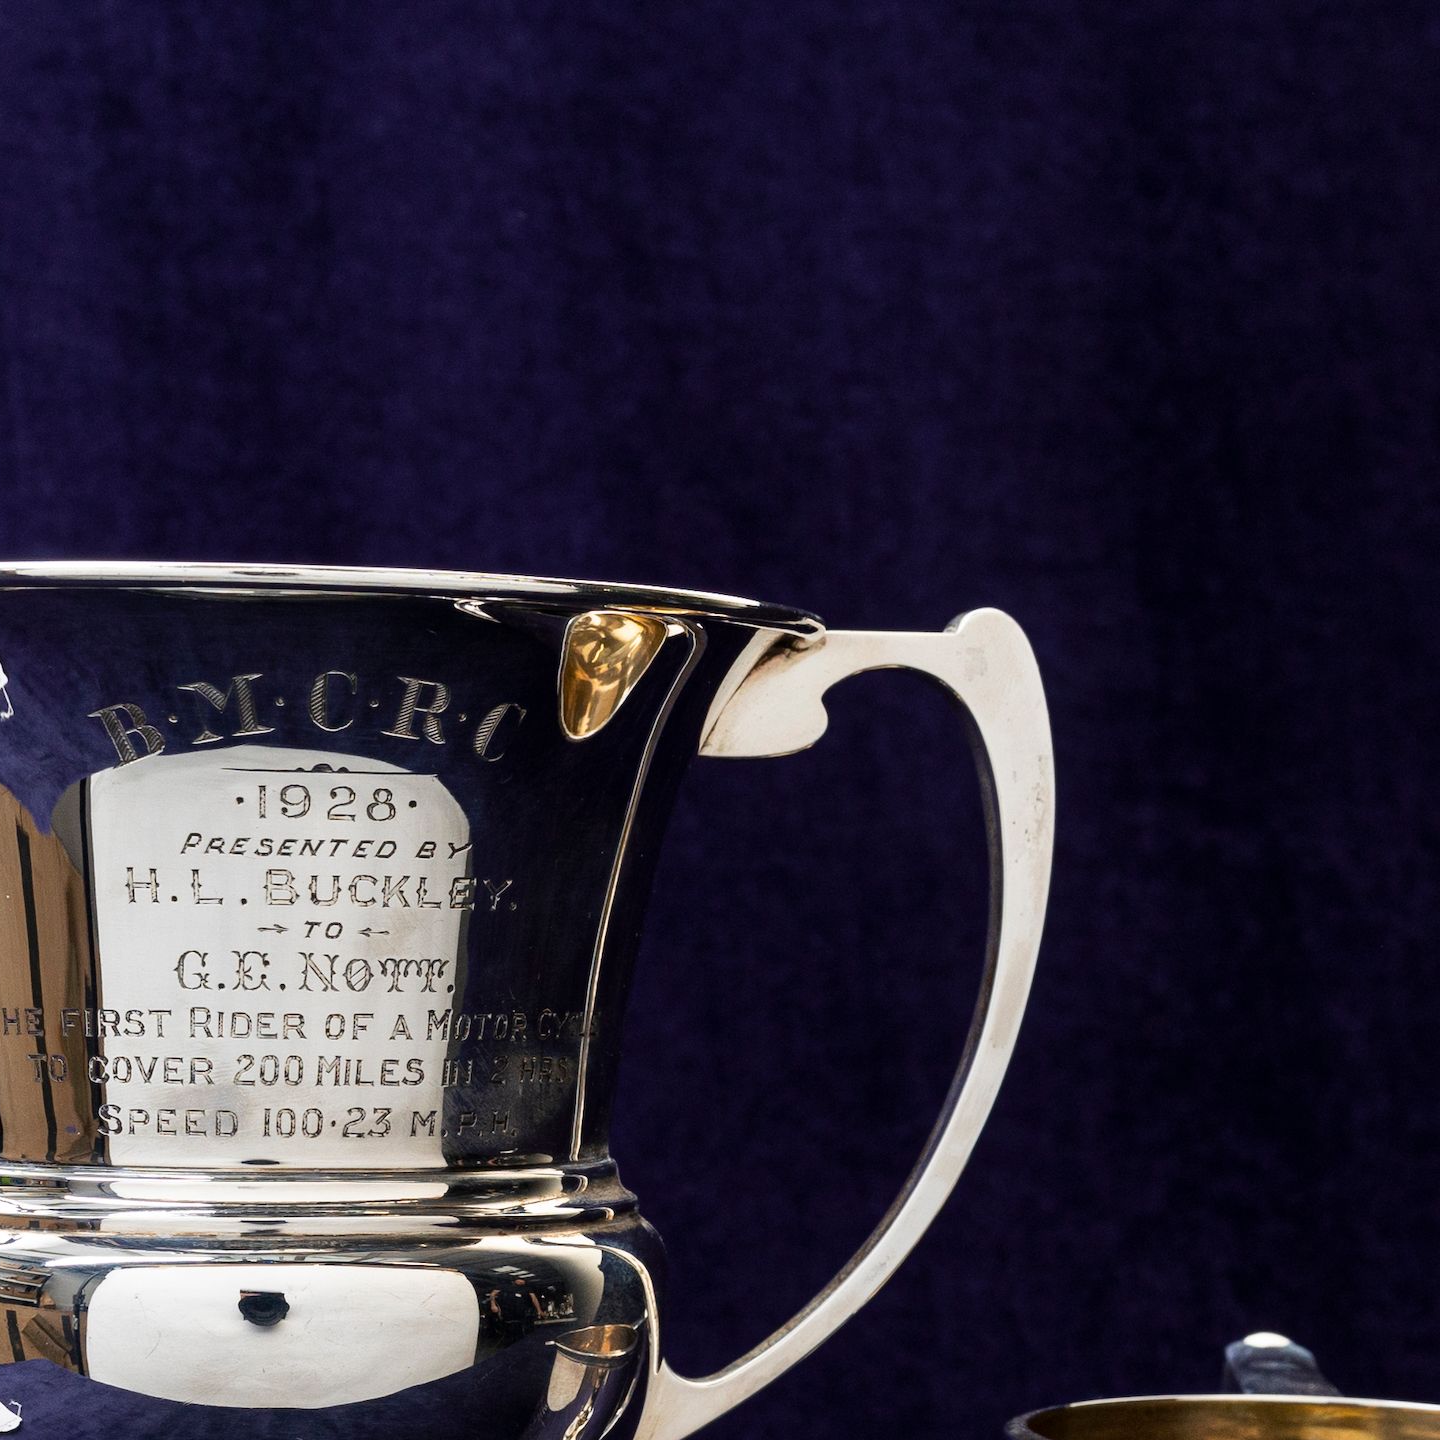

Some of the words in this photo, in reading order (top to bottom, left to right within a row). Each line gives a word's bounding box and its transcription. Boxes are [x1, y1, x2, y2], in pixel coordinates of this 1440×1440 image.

[181, 832, 397, 859] PRESENTED
[416, 841, 475, 860] BY
[304, 921, 343, 939] TO
[60, 1007, 172, 1039] FIRST
[189, 1006, 308, 1040] RIDER
[325, 1013, 375, 1041] OF
[389, 1014, 413, 1041] A
[426, 1008, 528, 1041] MOTOR
[28, 1053, 68, 1083] TO
[88, 1054, 215, 1086] COVER
[232, 1054, 304, 1086] 200
[316, 1055, 425, 1087] MILES
[441, 1058, 473, 1088] IN
[490, 1055, 509, 1085] 2
[97, 1104, 239, 1137] SPEED
[410, 1109, 518, 1138] M.P.H.
